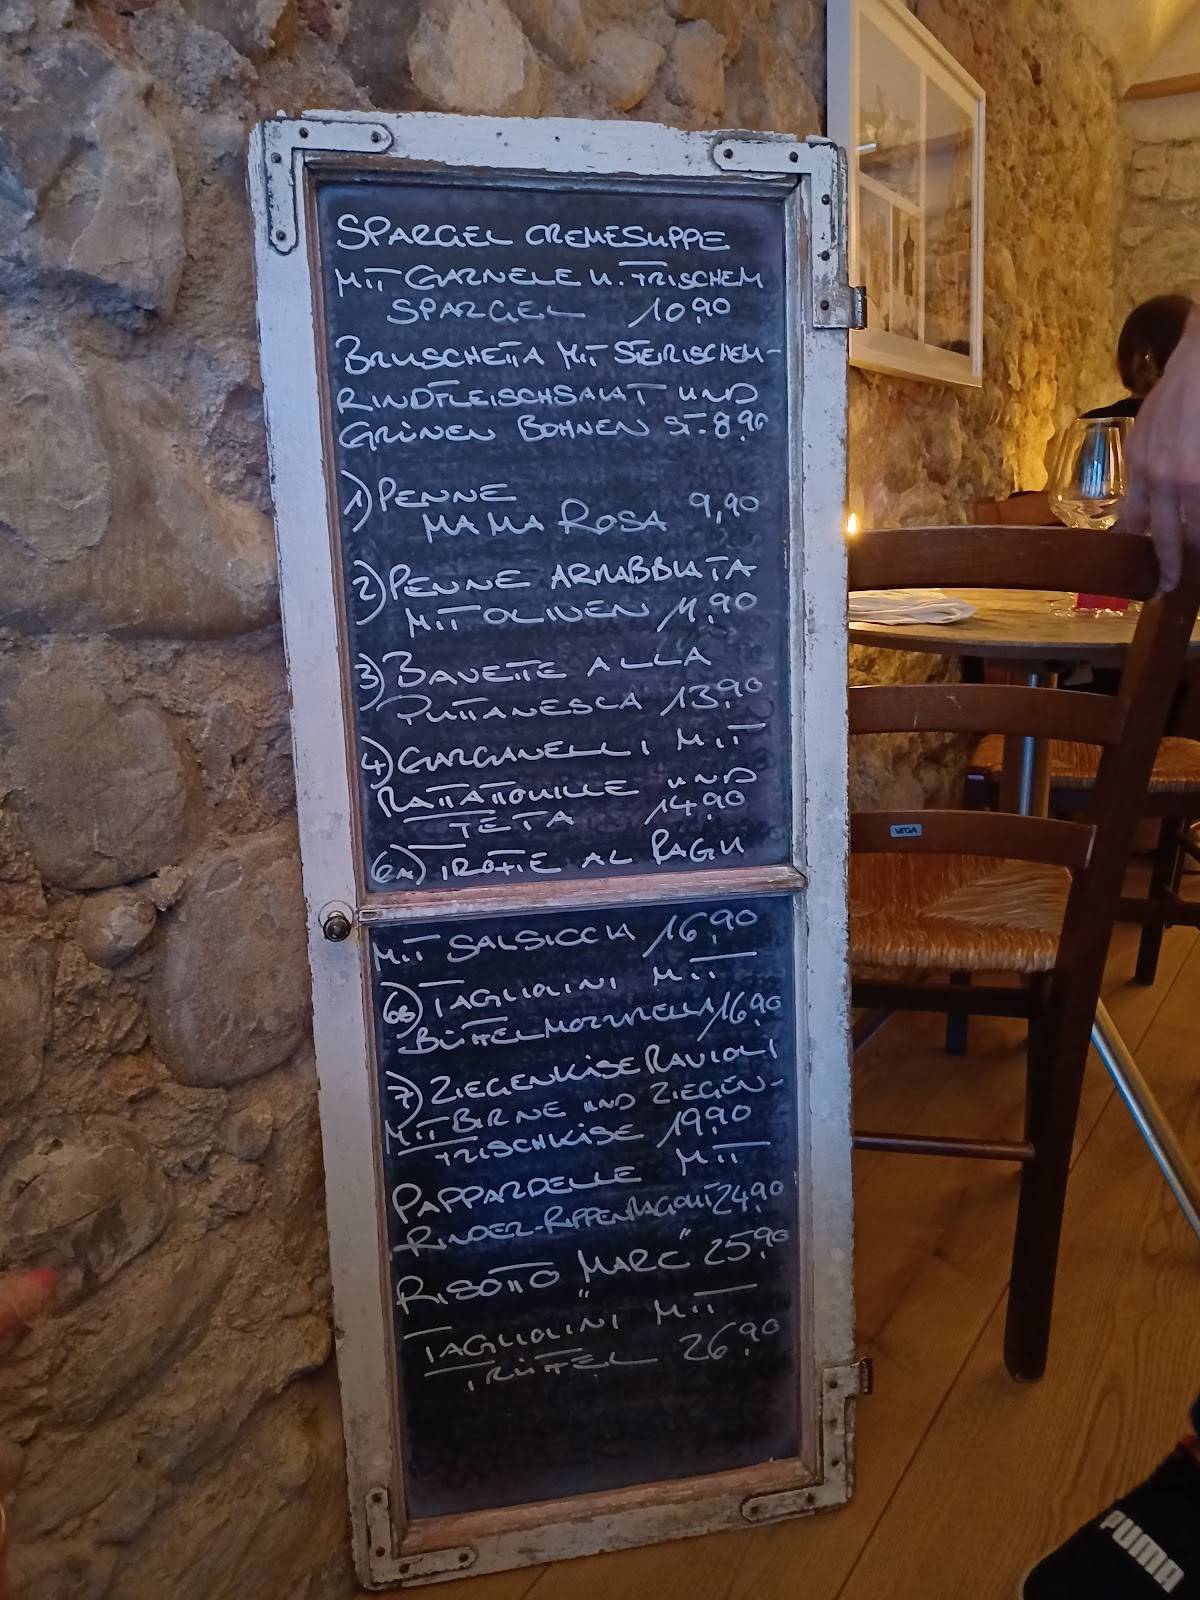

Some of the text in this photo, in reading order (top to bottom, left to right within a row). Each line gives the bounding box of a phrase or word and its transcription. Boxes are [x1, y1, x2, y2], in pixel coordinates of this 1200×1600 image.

[337, 214, 730, 250] SPARGEL CREMESUPPE
[335, 267, 402, 297] MIT
[405, 264, 581, 289] GARNELE
[590, 265, 623, 287] U.
[387, 298, 730, 328] SPARGEL 10,90
[335, 336, 544, 374] BRUSCHETTA
[557, 340, 608, 368] MIT
[679, 383, 758, 404] UND
[338, 421, 496, 451] GRÜNEN
[518, 415, 649, 442] BOHNEN
[380, 476, 516, 512] PENNE
[689, 492, 760, 523] 9,90
[559, 498, 668, 534] ROSA
[389, 564, 530, 601] PENNE
[406, 605, 481, 638] MIT
[484, 601, 649, 624] OLIVEN
[382, 651, 566, 688] BAVETTE
[587, 647, 711, 678] ALLA
[376, 678, 763, 726] PUTTANESCA 13,90
[398, 739, 649, 774] GARGANELLI
[676, 722, 766, 751] MIT
[668, 767, 757, 788] UND
[644, 791, 745, 825] 14,90
[582, 847, 632, 869] AL
[651, 828, 744, 866] RAGU
[894, 826, 918, 835] VEGA
[372, 910, 758, 971] MIT SALSICCIA 16,90
[419, 976, 617, 1018] TAGLIOLINI
[652, 952, 757, 986] MIT
[697, 990, 781, 1042] 16,90
[645, 1038, 778, 1074] RAVIOLI
[384, 1116, 450, 1154] MIT
[452, 1101, 566, 1134] BIRNE
[583, 1092, 636, 1111] UND
[657, 1104, 751, 1149] 19,90
[392, 1141, 771, 1224] PAPPARDELLE MIT
[713, 1180, 784, 1214] 24,90
[396, 1261, 559, 1314] RISOTTO
[704, 1227, 789, 1266] 25,90
[404, 1284, 758, 1362] TAGLIOLINI MIT
[679, 1318, 780, 1361] 26,90
